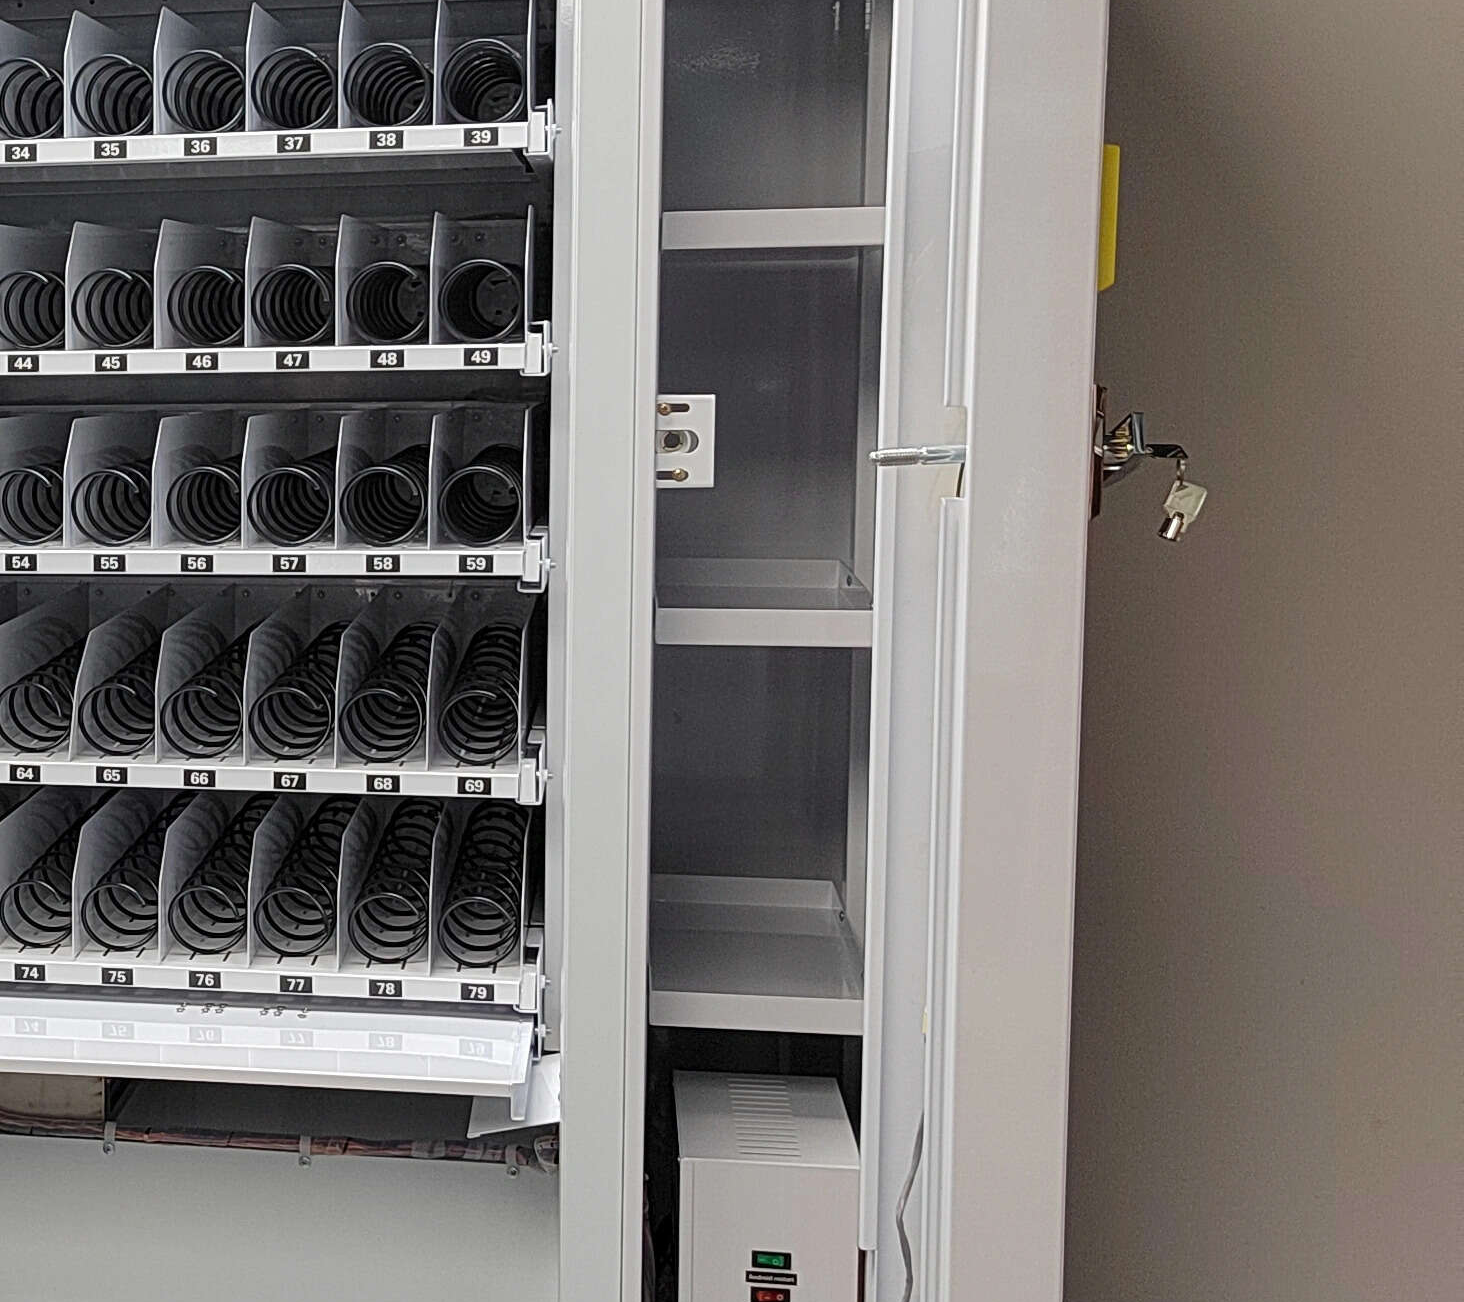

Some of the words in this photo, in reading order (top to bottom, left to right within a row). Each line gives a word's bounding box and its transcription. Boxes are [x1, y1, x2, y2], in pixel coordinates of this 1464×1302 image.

[11, 146, 31, 160] 34
[100, 142, 120, 157] 35
[190, 139, 211, 154] 36
[284, 136, 304, 151] 37
[376, 132, 397, 147] 38
[470, 129, 492, 144] 39
[13, 356, 33, 370] 44
[101, 355, 121, 370] 45
[192, 354, 212, 369] 46
[283, 353, 303, 367] 47
[377, 351, 398, 366] 48
[470, 349, 492, 364] 49
[11, 555, 31, 569] 54
[100, 556, 119, 570] 55
[187, 556, 207, 570] 56
[280, 556, 299, 570] 57
[373, 556, 393, 571] 58
[466, 556, 487, 571] 59
[16, 766, 34, 780] 64
[102, 768, 121, 782] 65
[190, 771, 209, 785] 66
[280, 774, 299, 788] 67
[373, 777, 393, 791] 68
[464, 778, 485, 793] 69
[20, 966, 40, 979] 74
[108, 970, 127, 983] 75
[195, 973, 215, 987] 76
[286, 978, 305, 992] 77
[376, 982, 396, 996] 78
[468, 985, 488, 1000] 79
